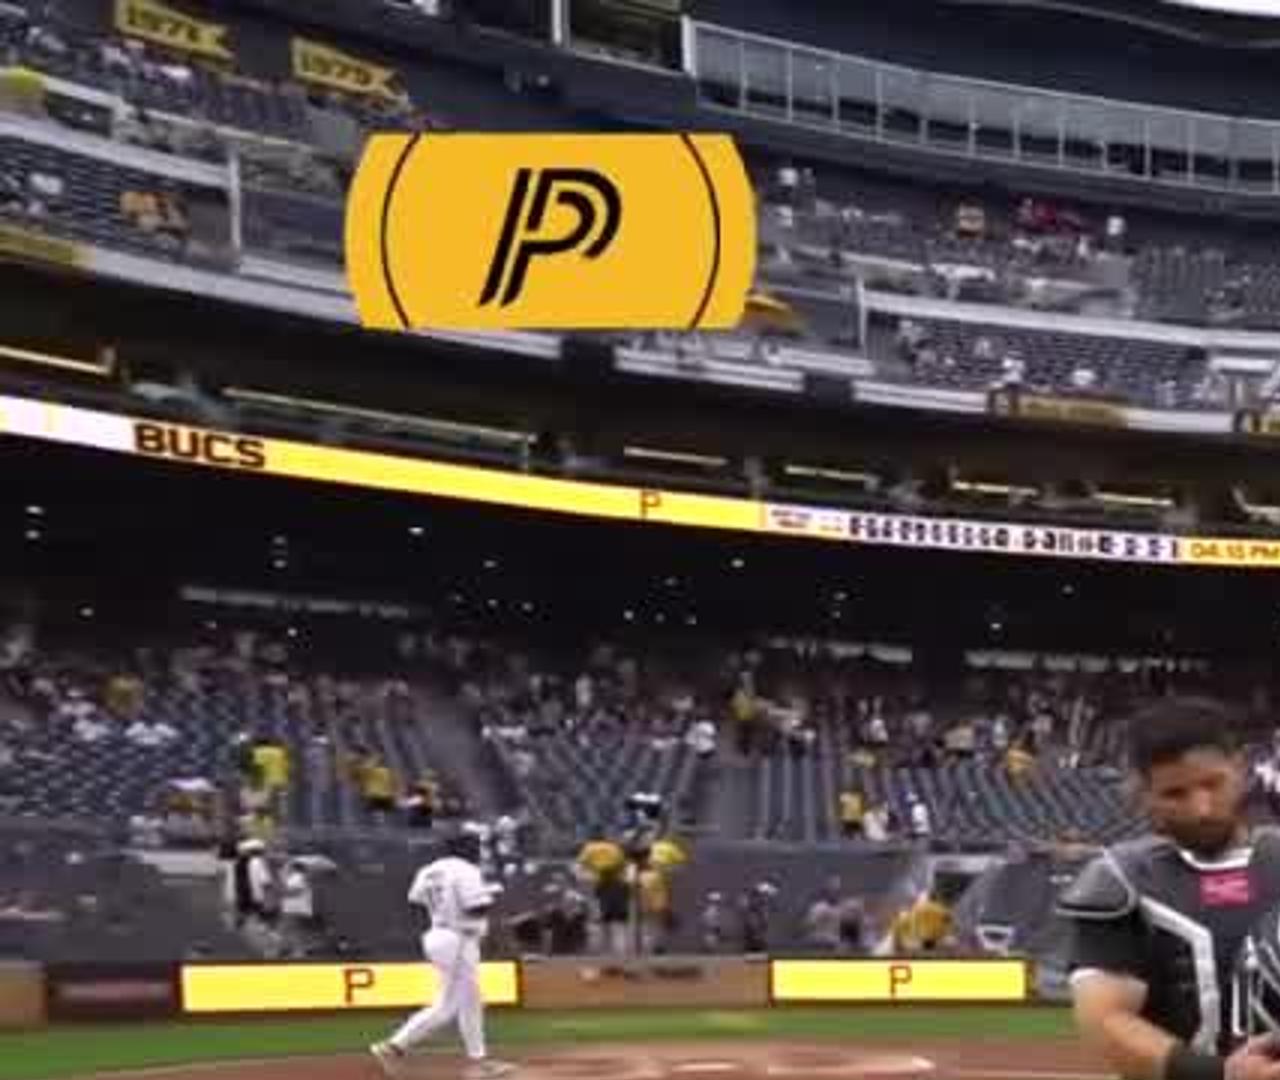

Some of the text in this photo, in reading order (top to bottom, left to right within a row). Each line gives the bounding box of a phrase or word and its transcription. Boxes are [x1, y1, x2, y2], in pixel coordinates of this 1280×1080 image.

[134, 423, 266, 470] BUCS
[640, 489, 662, 519] P
[343, 966, 376, 1005] P
[889, 964, 913, 999] P
